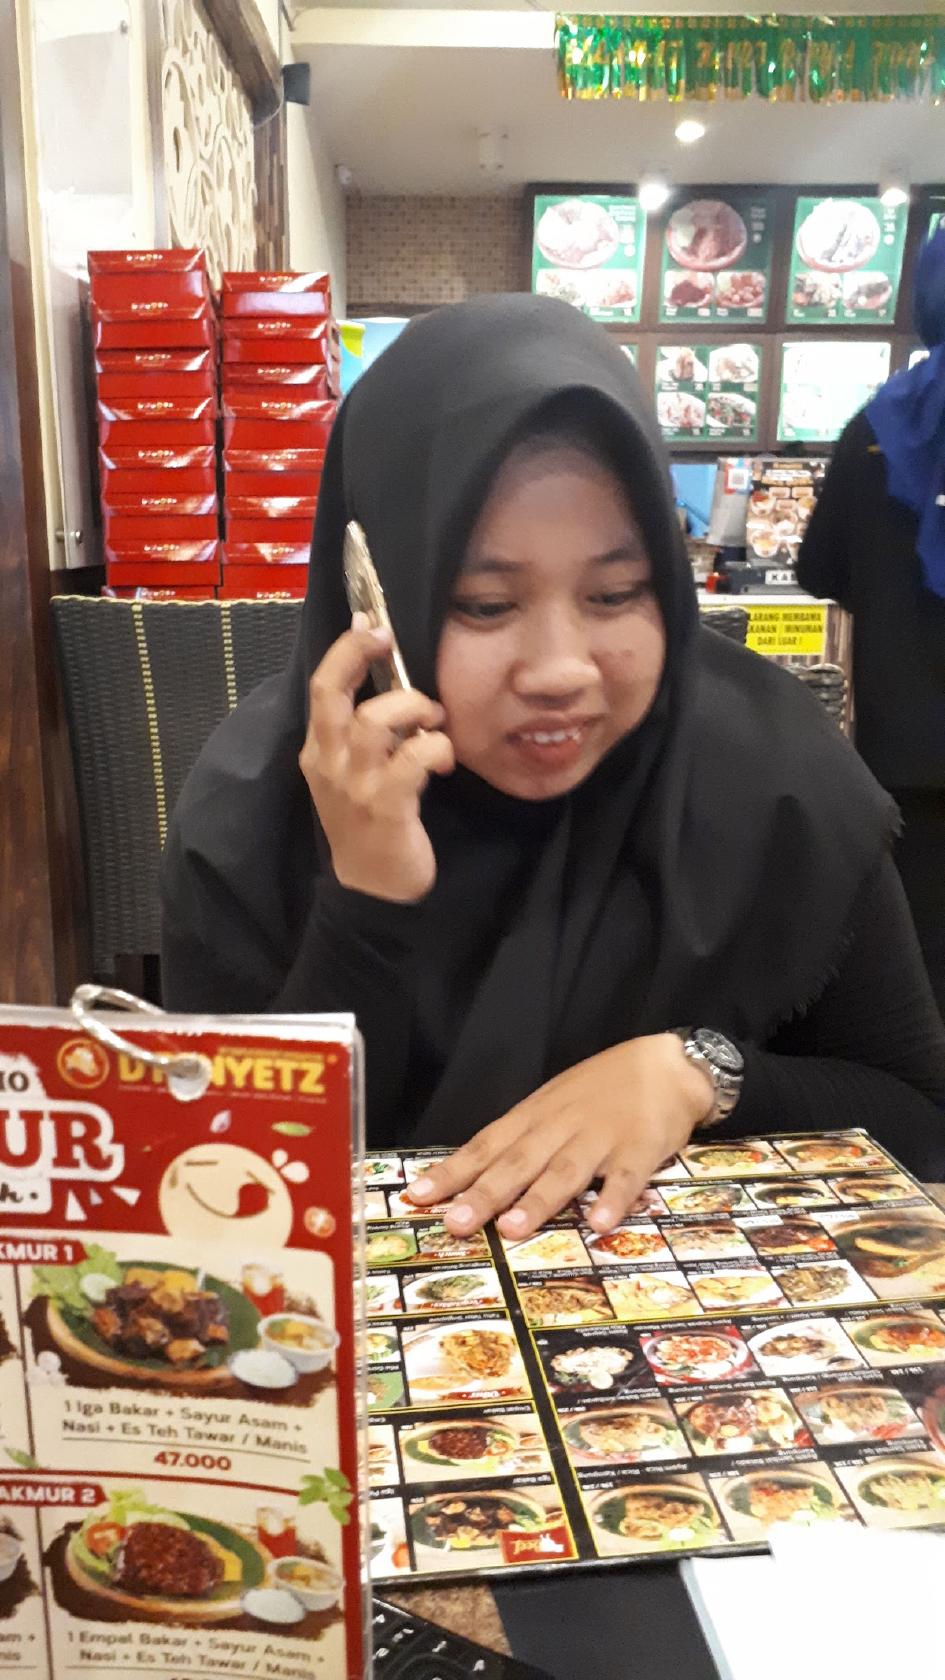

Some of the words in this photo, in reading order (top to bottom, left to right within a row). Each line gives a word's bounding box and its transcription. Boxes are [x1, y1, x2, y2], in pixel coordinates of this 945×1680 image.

[63, 1245, 72, 1261] 1
[64, 1401, 71, 1412] 1
[77, 1401, 103, 1415] Iga
[110, 1401, 159, 1418] Bakar
[166, 1410, 175, 1418] +
[181, 1407, 232, 1425] Sayur
[239, 1412, 287, 1431] Asam
[293, 1423, 302, 1432] +
[62, 1419, 100, 1435] Nasi
[106, 1424, 115, 1432] +
[122, 1420, 142, 1436] Es
[148, 1423, 178, 1438] Teh
[185, 1426, 235, 1444] Tawar
[241, 1430, 249, 1444] /
[255, 1432, 308, 1454] Manis
[154, 1451, 232, 1472] 47.000
[81, 1489, 95, 1503] 2
[68, 1633, 73, 1643] 1
[80, 1633, 134, 1649] Empal
[140, 1634, 188, 1648] Bakar
[194, 1639, 203, 1648] +
[208, 1638, 257, 1656] Sayur
[264, 1643, 311, 1663] Asam
[80, 1649, 116, 1662] Nasi
[137, 1651, 156, 1663] Es
[164, 1653, 192, 1666] Teh
[198, 1654, 247, 1670] Tawar
[265, 1661, 315, 1679] Manis
